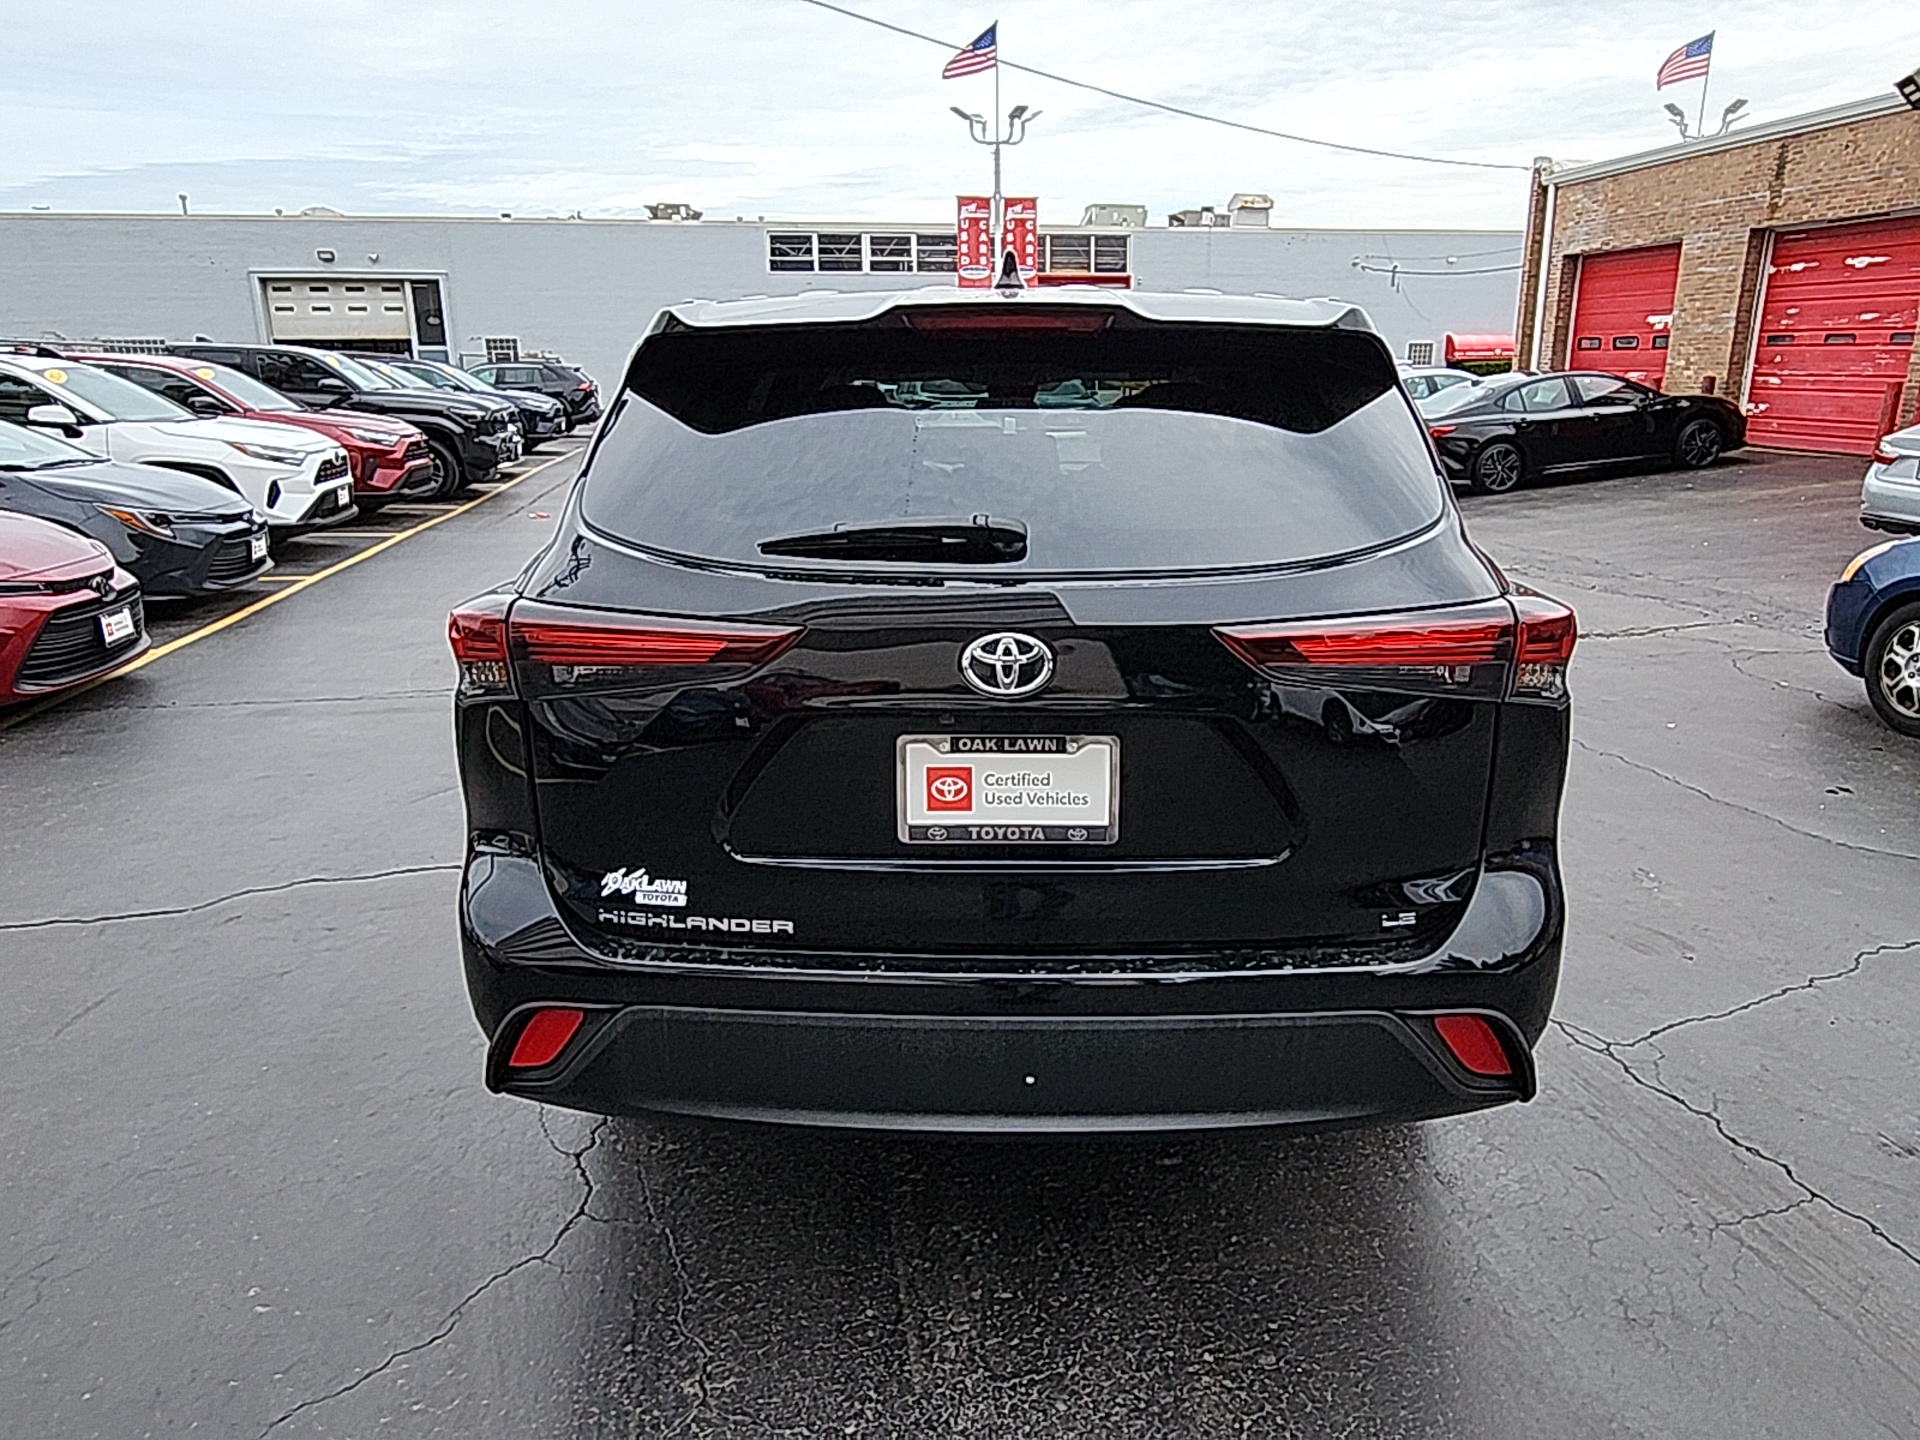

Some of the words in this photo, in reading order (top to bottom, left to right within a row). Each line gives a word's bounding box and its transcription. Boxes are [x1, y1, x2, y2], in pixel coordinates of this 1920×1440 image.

[960, 219, 970, 265] USED
[979, 220, 988, 266] CARS
[1025, 220, 1035, 266] CARS
[958, 738, 998, 751] OAK
[1004, 739, 1057, 751] LAWN
[983, 773, 1051, 787] Certified
[984, 792, 1023, 805] Used
[1026, 792, 1089, 806] Vehicles
[967, 827, 1045, 840] TOYOTA
[642, 893, 679, 903] TOYOTA
[598, 908, 794, 934] HIGHLANDER
